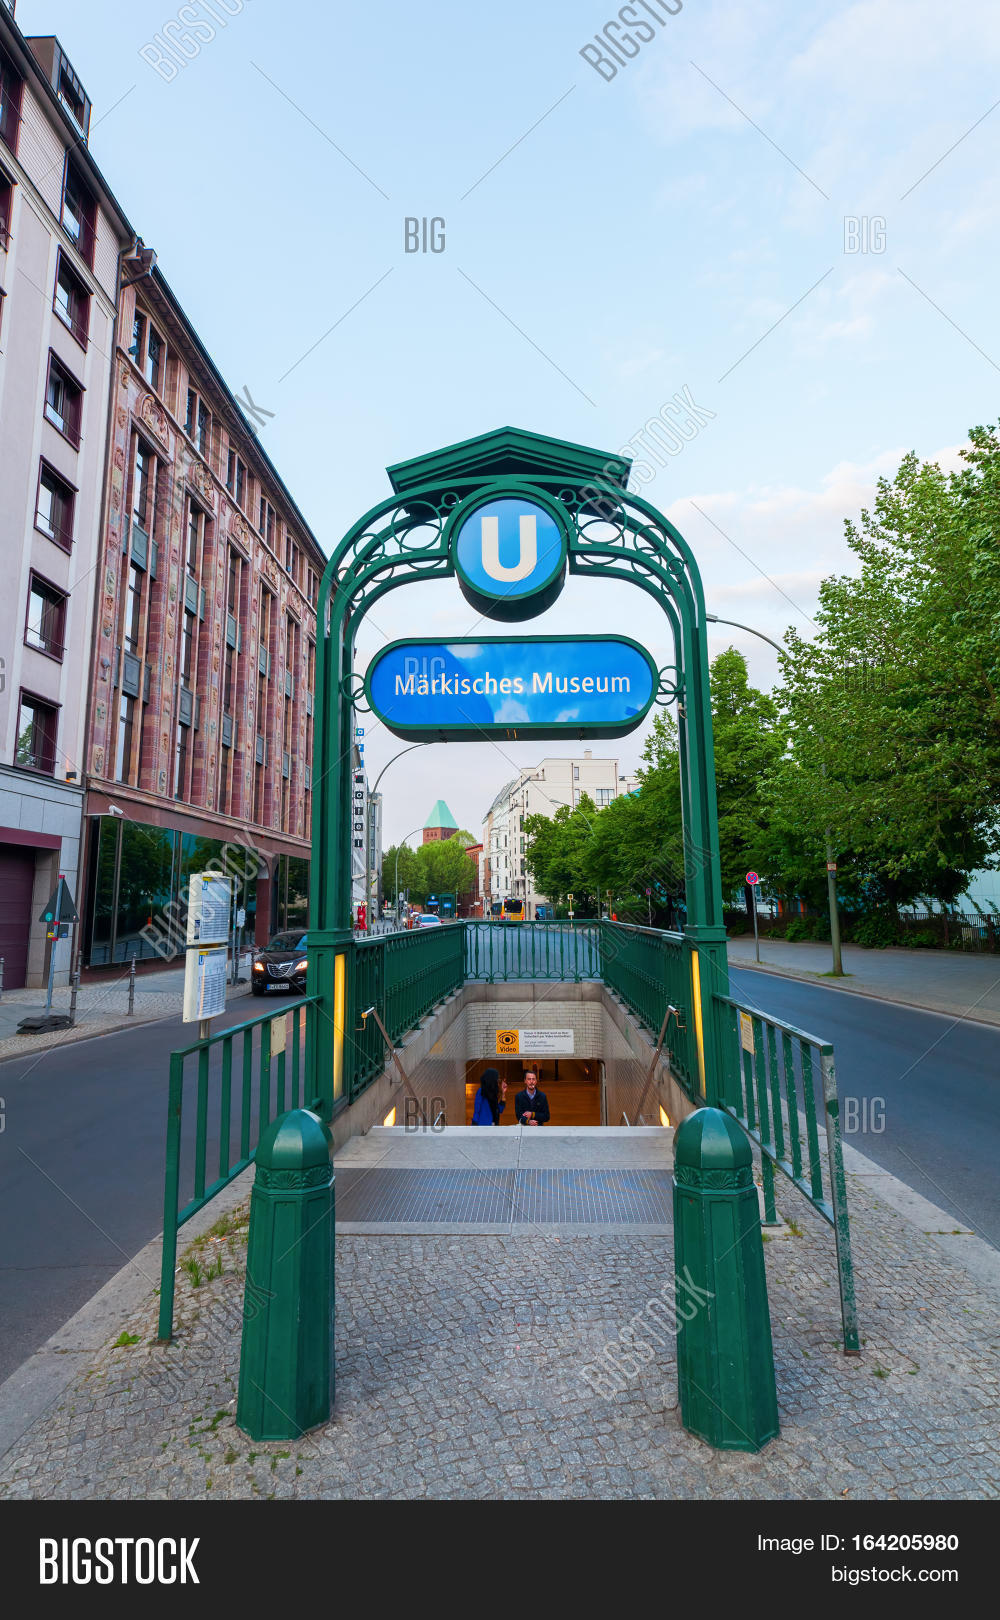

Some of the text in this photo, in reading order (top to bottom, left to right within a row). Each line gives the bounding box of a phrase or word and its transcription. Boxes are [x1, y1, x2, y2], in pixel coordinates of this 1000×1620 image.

[481, 515, 537, 582] U
[395, 671, 631, 695] Märkisches Museum
